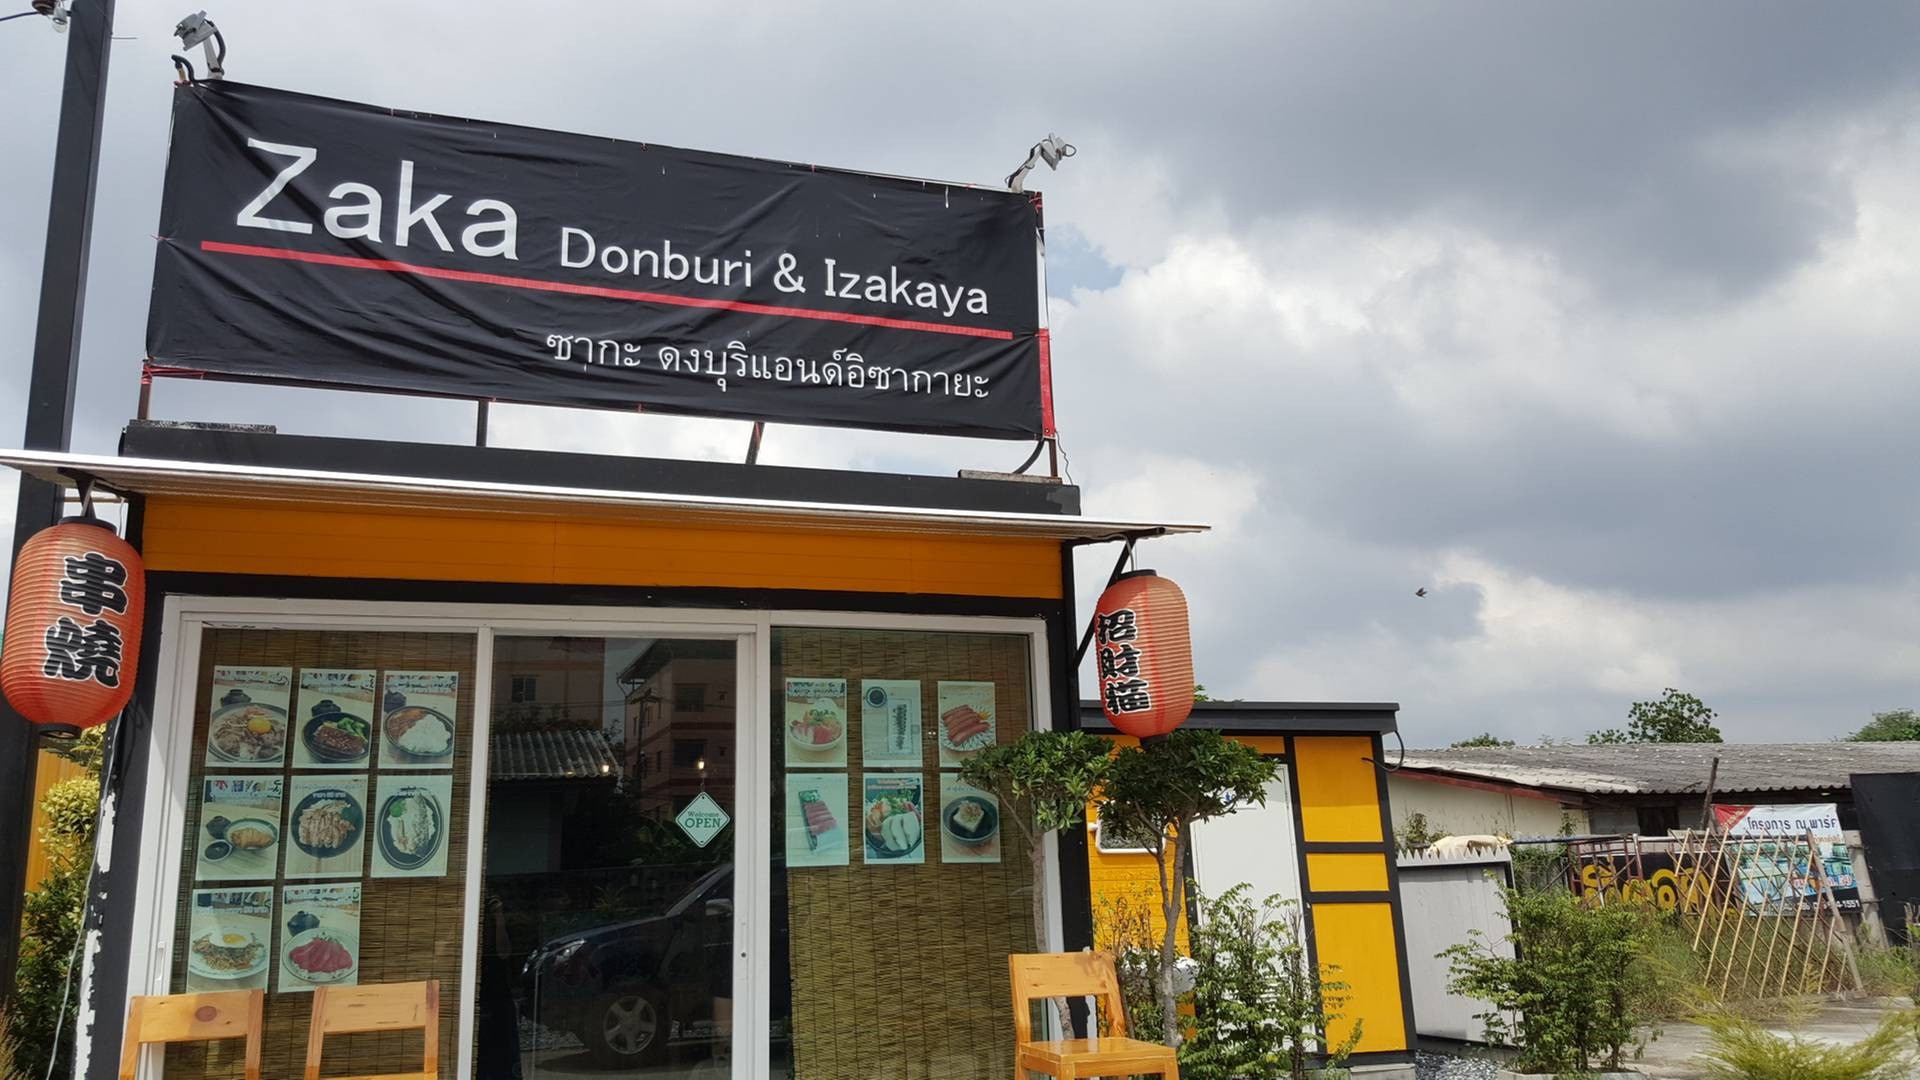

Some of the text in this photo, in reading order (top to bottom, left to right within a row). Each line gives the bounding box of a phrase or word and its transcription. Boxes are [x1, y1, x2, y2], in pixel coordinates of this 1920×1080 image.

[236, 138, 989, 318] Zaka Donburi & Izakaya
[546, 333, 989, 399] ซากะ ดงบุริแอนด์อิซากายะ
[685, 818, 721, 828] OPEN
[1747, 817, 1791, 830] โครงการ
